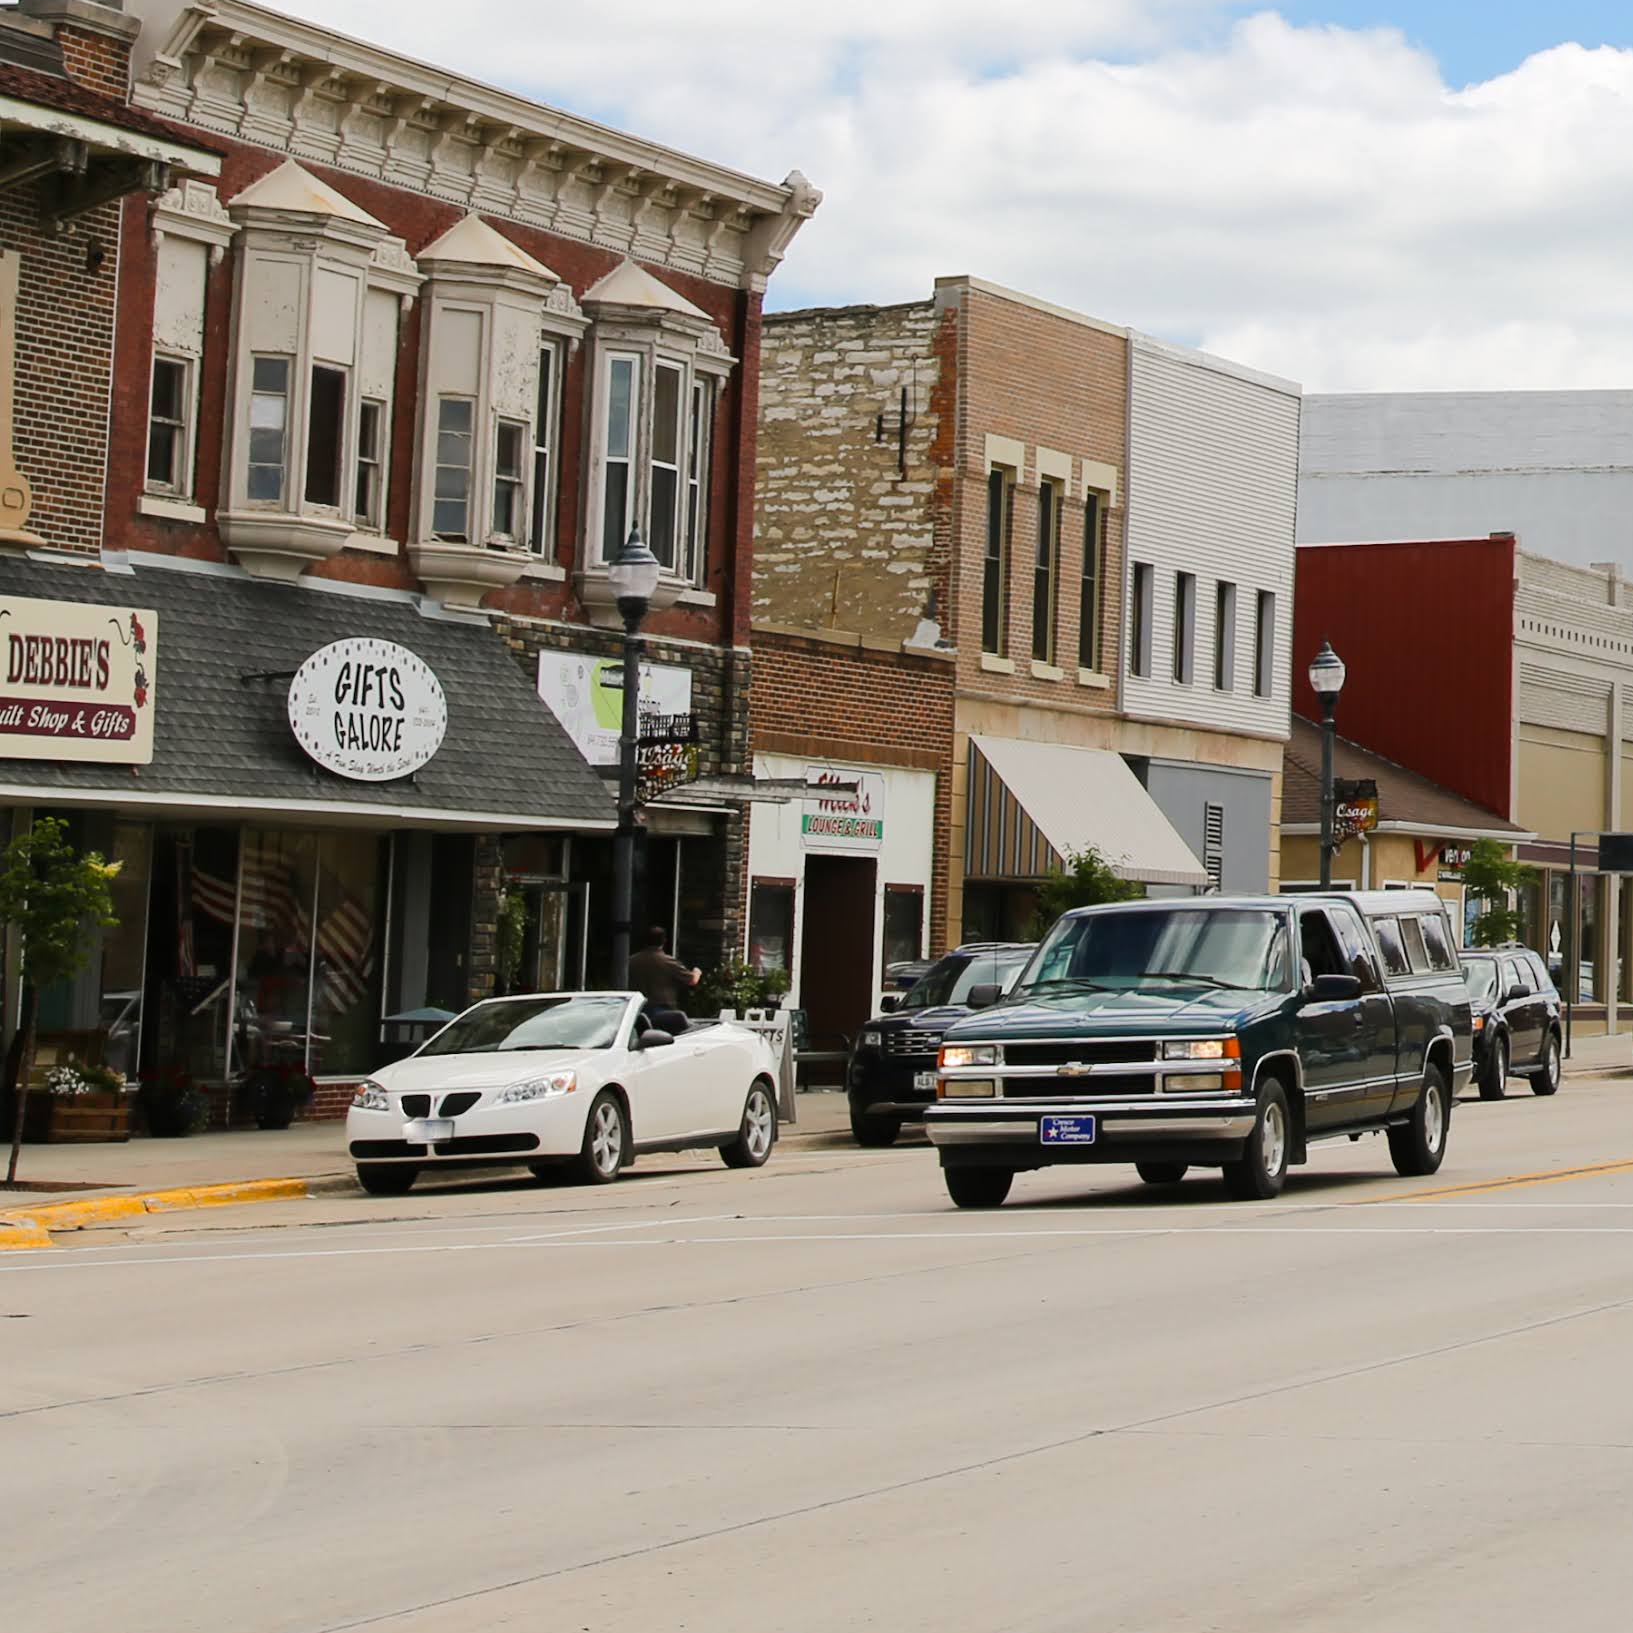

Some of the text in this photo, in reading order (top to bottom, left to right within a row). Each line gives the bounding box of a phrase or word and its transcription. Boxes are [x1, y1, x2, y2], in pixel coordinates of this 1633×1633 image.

[7, 633, 110, 691] DEBBIE'S
[334, 661, 405, 711] GIFTS
[0, 704, 130, 738] uilt Shop & Gifts
[334, 711, 405, 753] GALORE
[807, 816, 843, 835] LOUNGE
[854, 821, 878, 837] GRILL
[1336, 803, 1375, 818] Osage
[1060, 1132, 1091, 1141] Company
